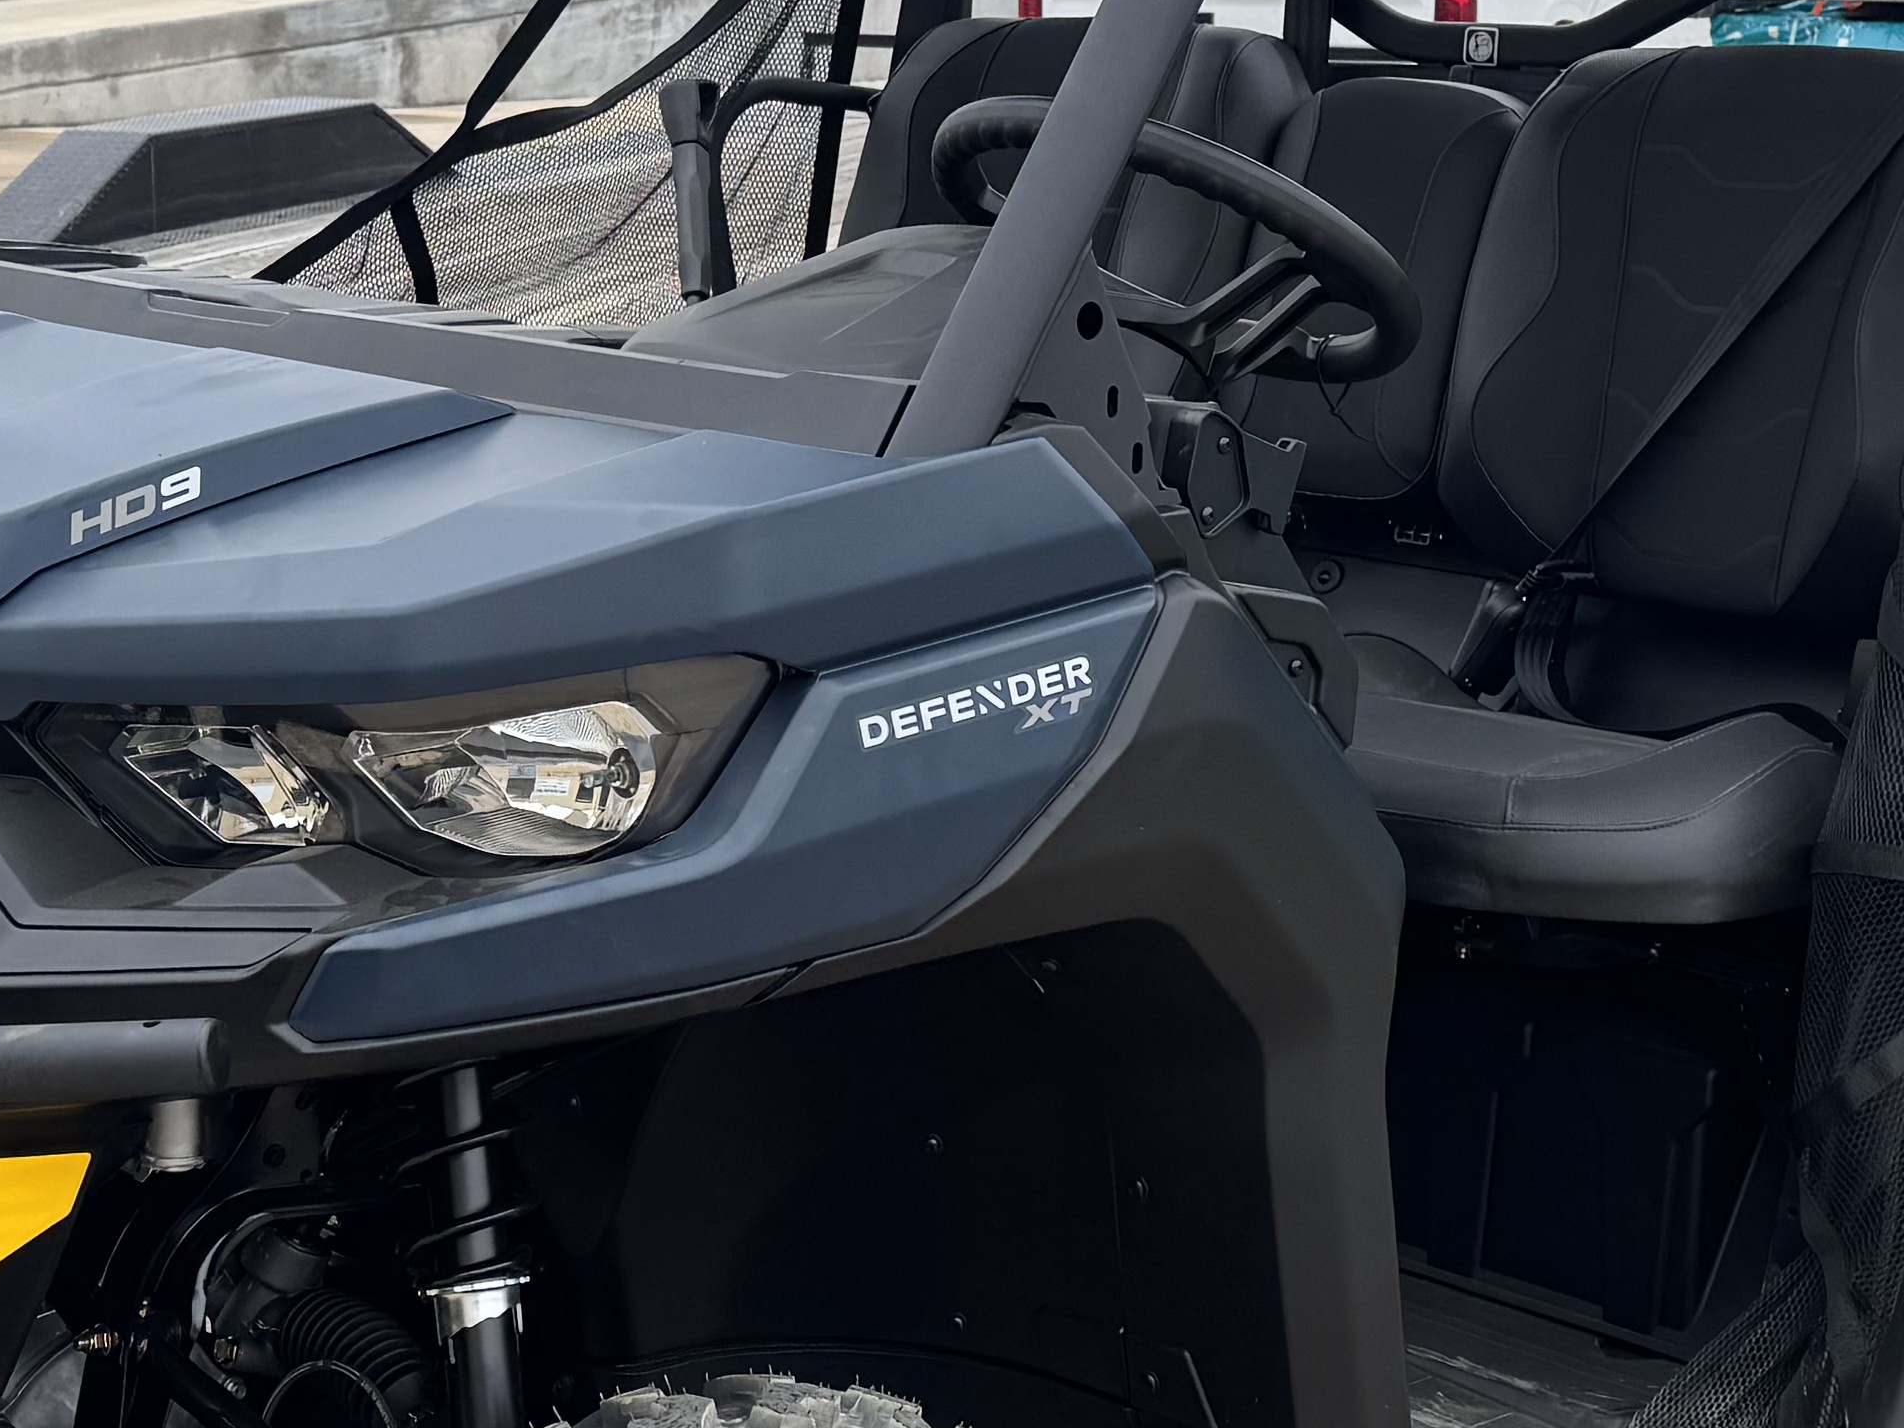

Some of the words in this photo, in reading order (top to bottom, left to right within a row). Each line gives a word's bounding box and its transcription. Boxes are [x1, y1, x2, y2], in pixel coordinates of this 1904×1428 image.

[70, 465, 201, 546] HD9
[858, 656, 1091, 749] DEFENDER
[1021, 688, 1093, 730] XT
